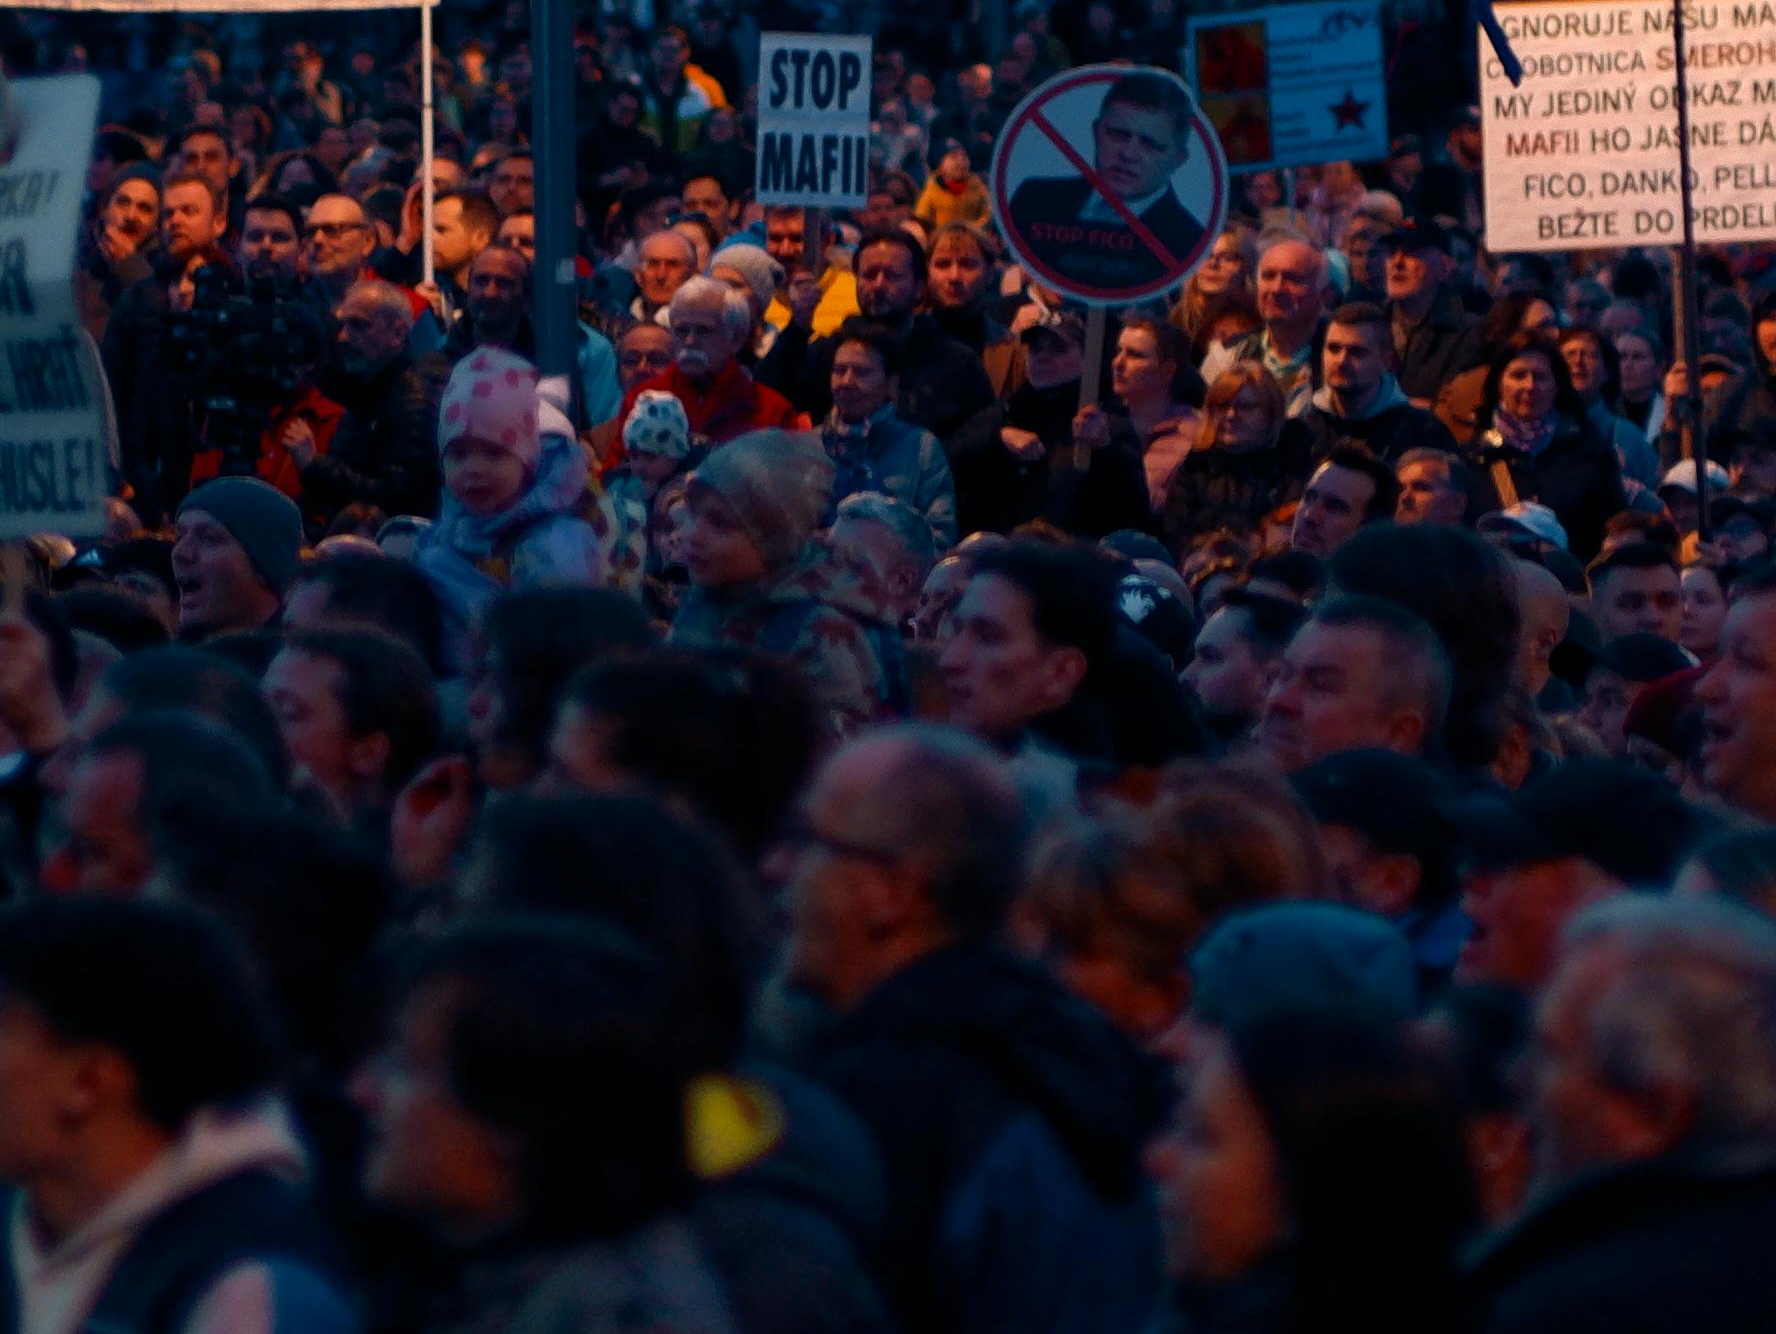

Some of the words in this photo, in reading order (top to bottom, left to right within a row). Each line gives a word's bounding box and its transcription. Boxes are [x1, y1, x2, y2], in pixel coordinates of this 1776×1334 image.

[1502, 11, 1633, 40] GNORUJE
[770, 49, 861, 109] STOP
[1486, 51, 1646, 80] COBOTNICA
[1494, 92, 1533, 119] MY
[1541, 81, 1637, 118] JEDINÝ
[1506, 130, 1580, 157] MAFII
[1590, 127, 1631, 153] HO
[760, 131, 865, 195] MAFII
[1524, 173, 1592, 201] FICO,
[1538, 210, 1618, 241] BEŽTE
[1634, 209, 1674, 235] DO
